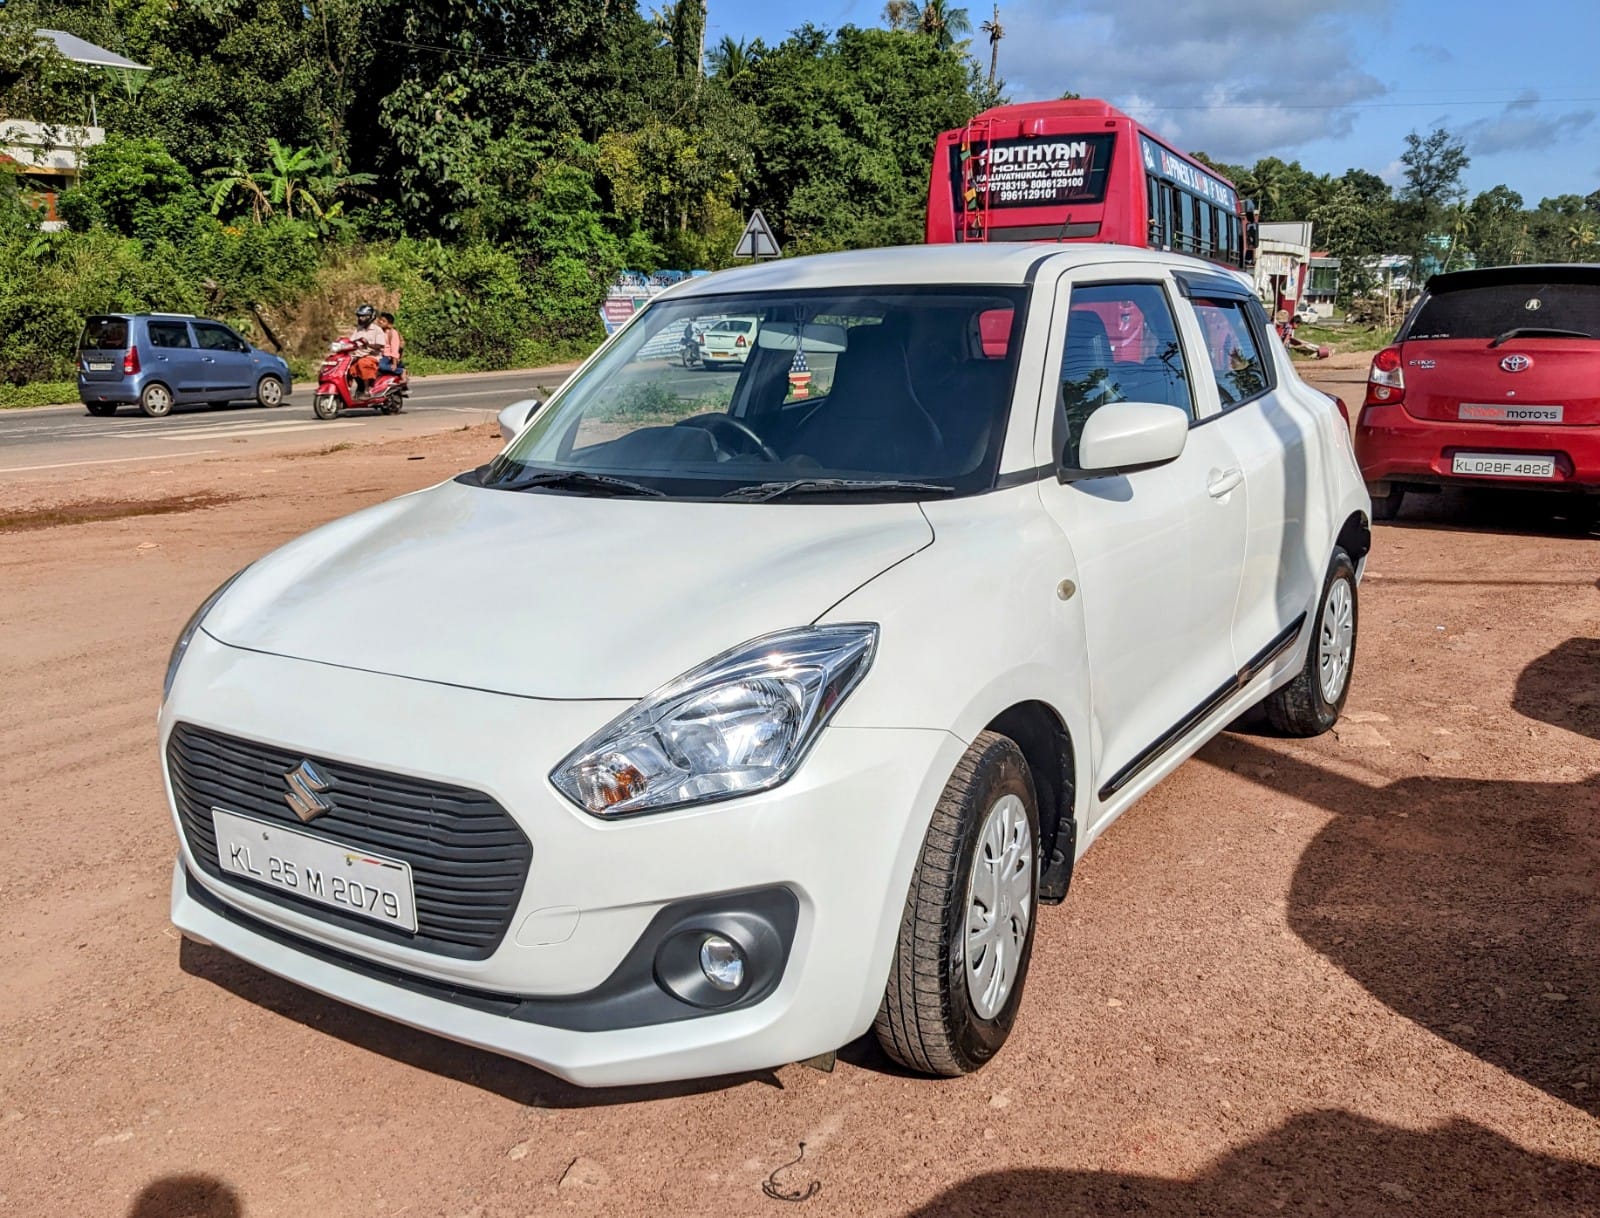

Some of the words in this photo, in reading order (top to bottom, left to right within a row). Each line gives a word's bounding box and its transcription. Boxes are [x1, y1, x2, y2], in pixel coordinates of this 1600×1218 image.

[992, 161, 1070, 173] HOLIDAYS
[1051, 168, 1085, 178] KOLLAM
[1000, 189, 1057, 201] 9961129101
[1506, 410, 1558, 420] MOTORS
[1455, 459, 1473, 472] KL
[1514, 463, 1552, 475] 4826
[230, 842, 263, 876] KL
[269, 857, 298, 888] 25
[306, 867, 326, 897] M
[331, 877, 401, 920] 2079
